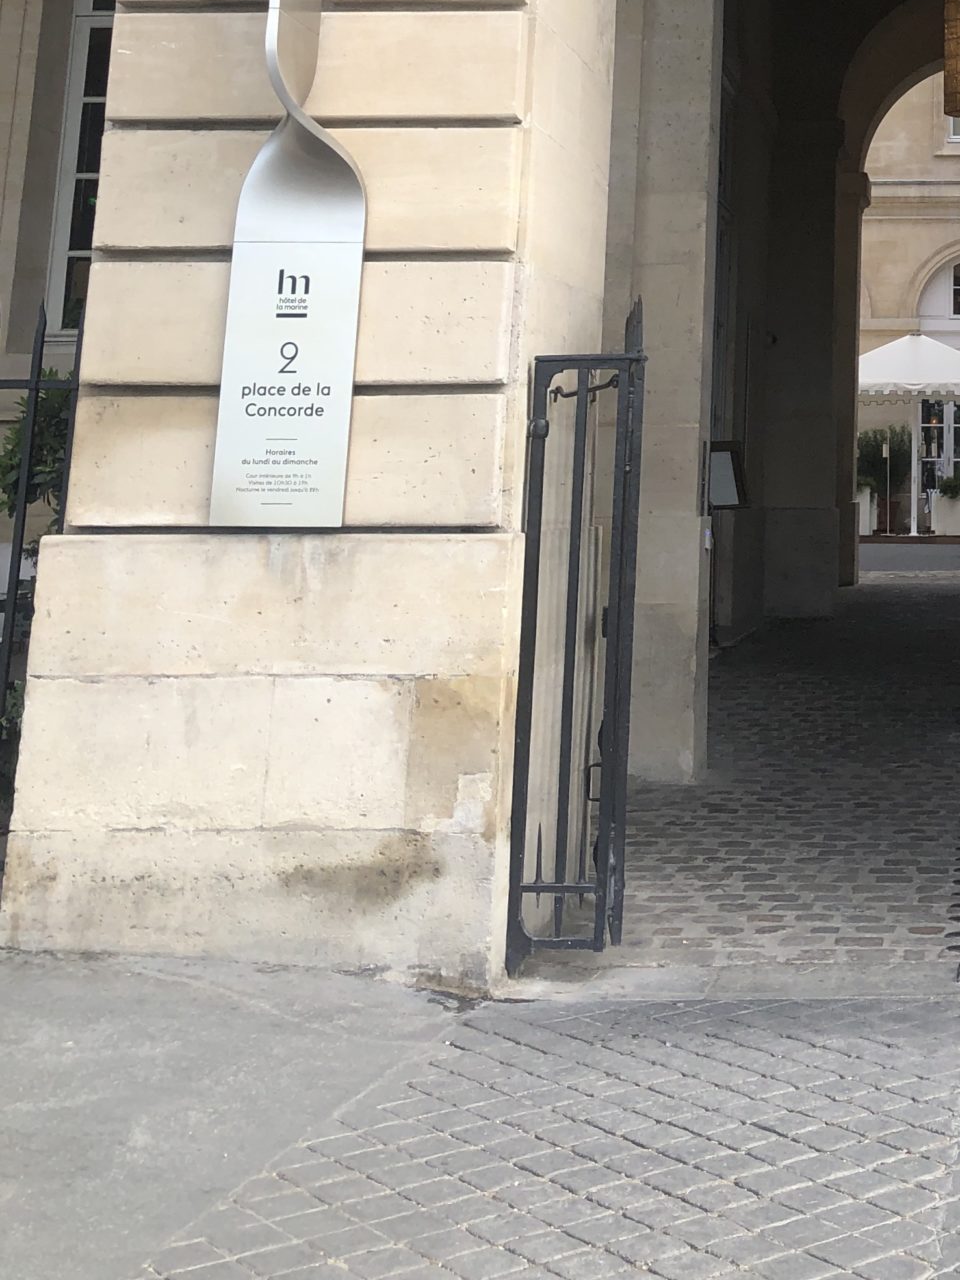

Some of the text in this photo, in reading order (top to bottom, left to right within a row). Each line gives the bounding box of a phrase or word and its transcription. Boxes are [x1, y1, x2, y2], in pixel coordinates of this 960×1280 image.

[277, 341, 299, 374] 2
[241, 382, 331, 399] place de la
[245, 403, 324, 417] Concorde
